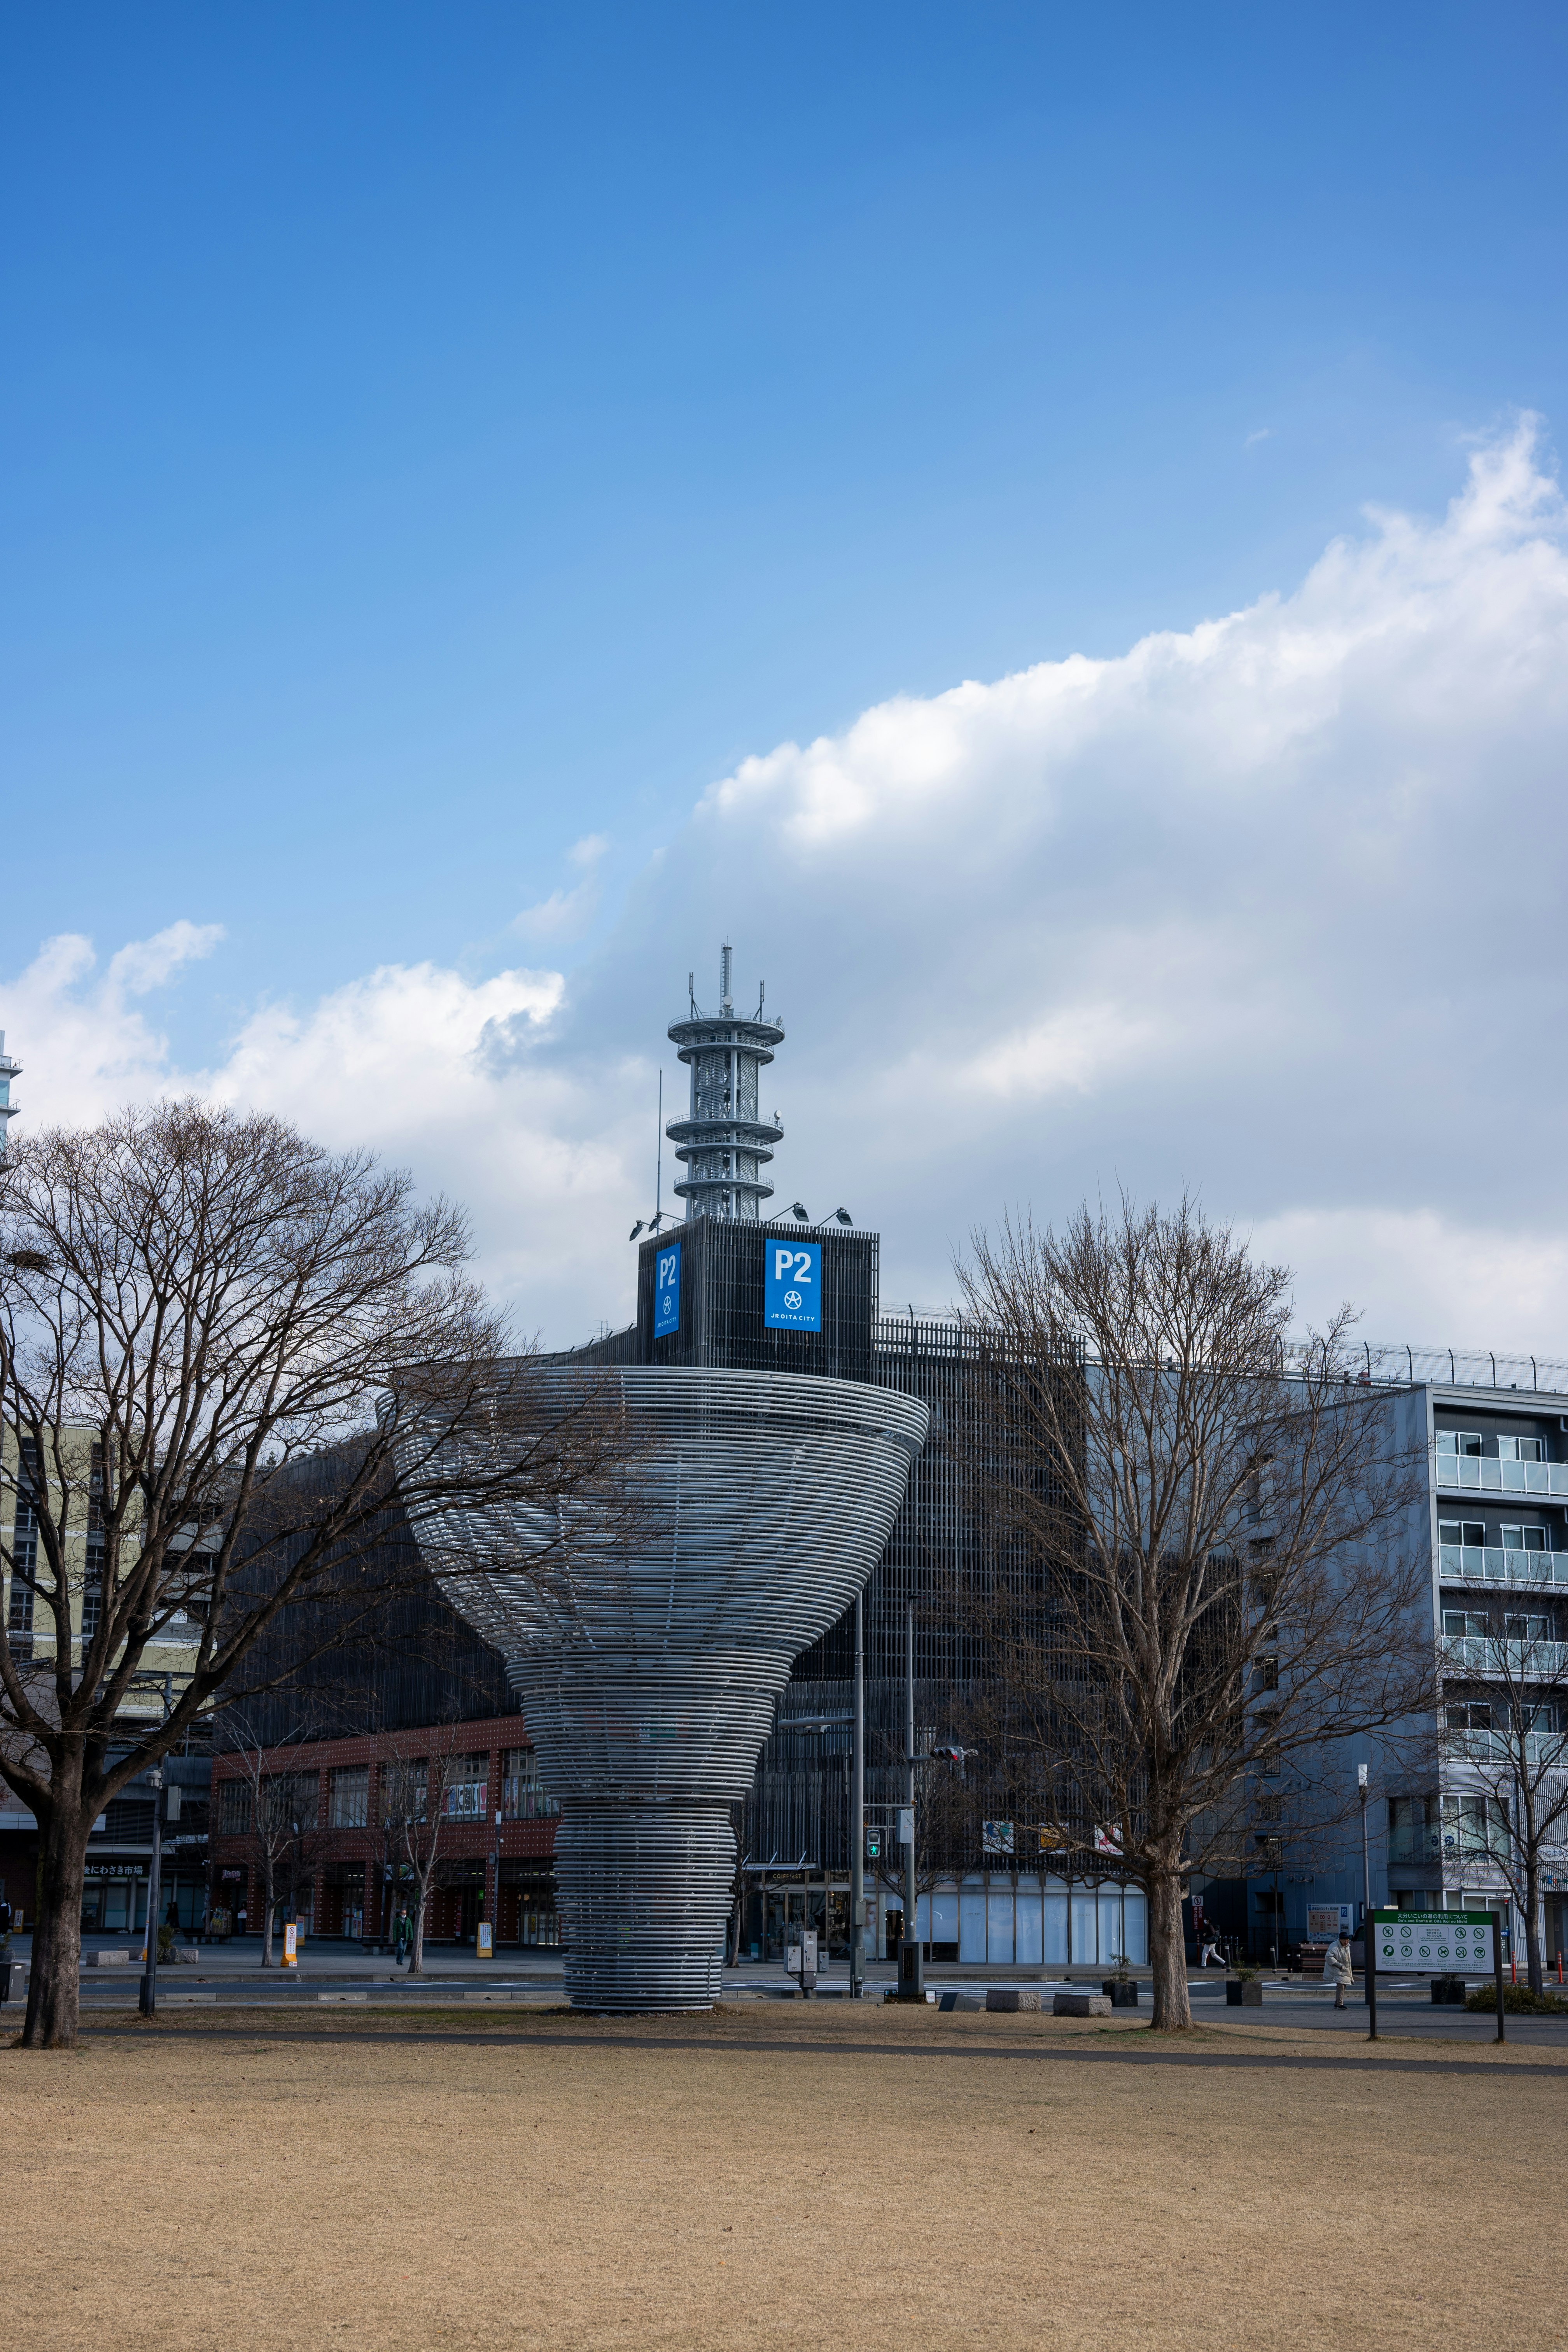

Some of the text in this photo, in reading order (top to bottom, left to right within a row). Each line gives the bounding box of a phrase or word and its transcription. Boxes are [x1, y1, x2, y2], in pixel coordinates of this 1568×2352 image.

[660, 1255, 676, 1290] P2
[775, 1249, 811, 1283] P2
[84, 1865, 144, 1875] 後にわさき市場
